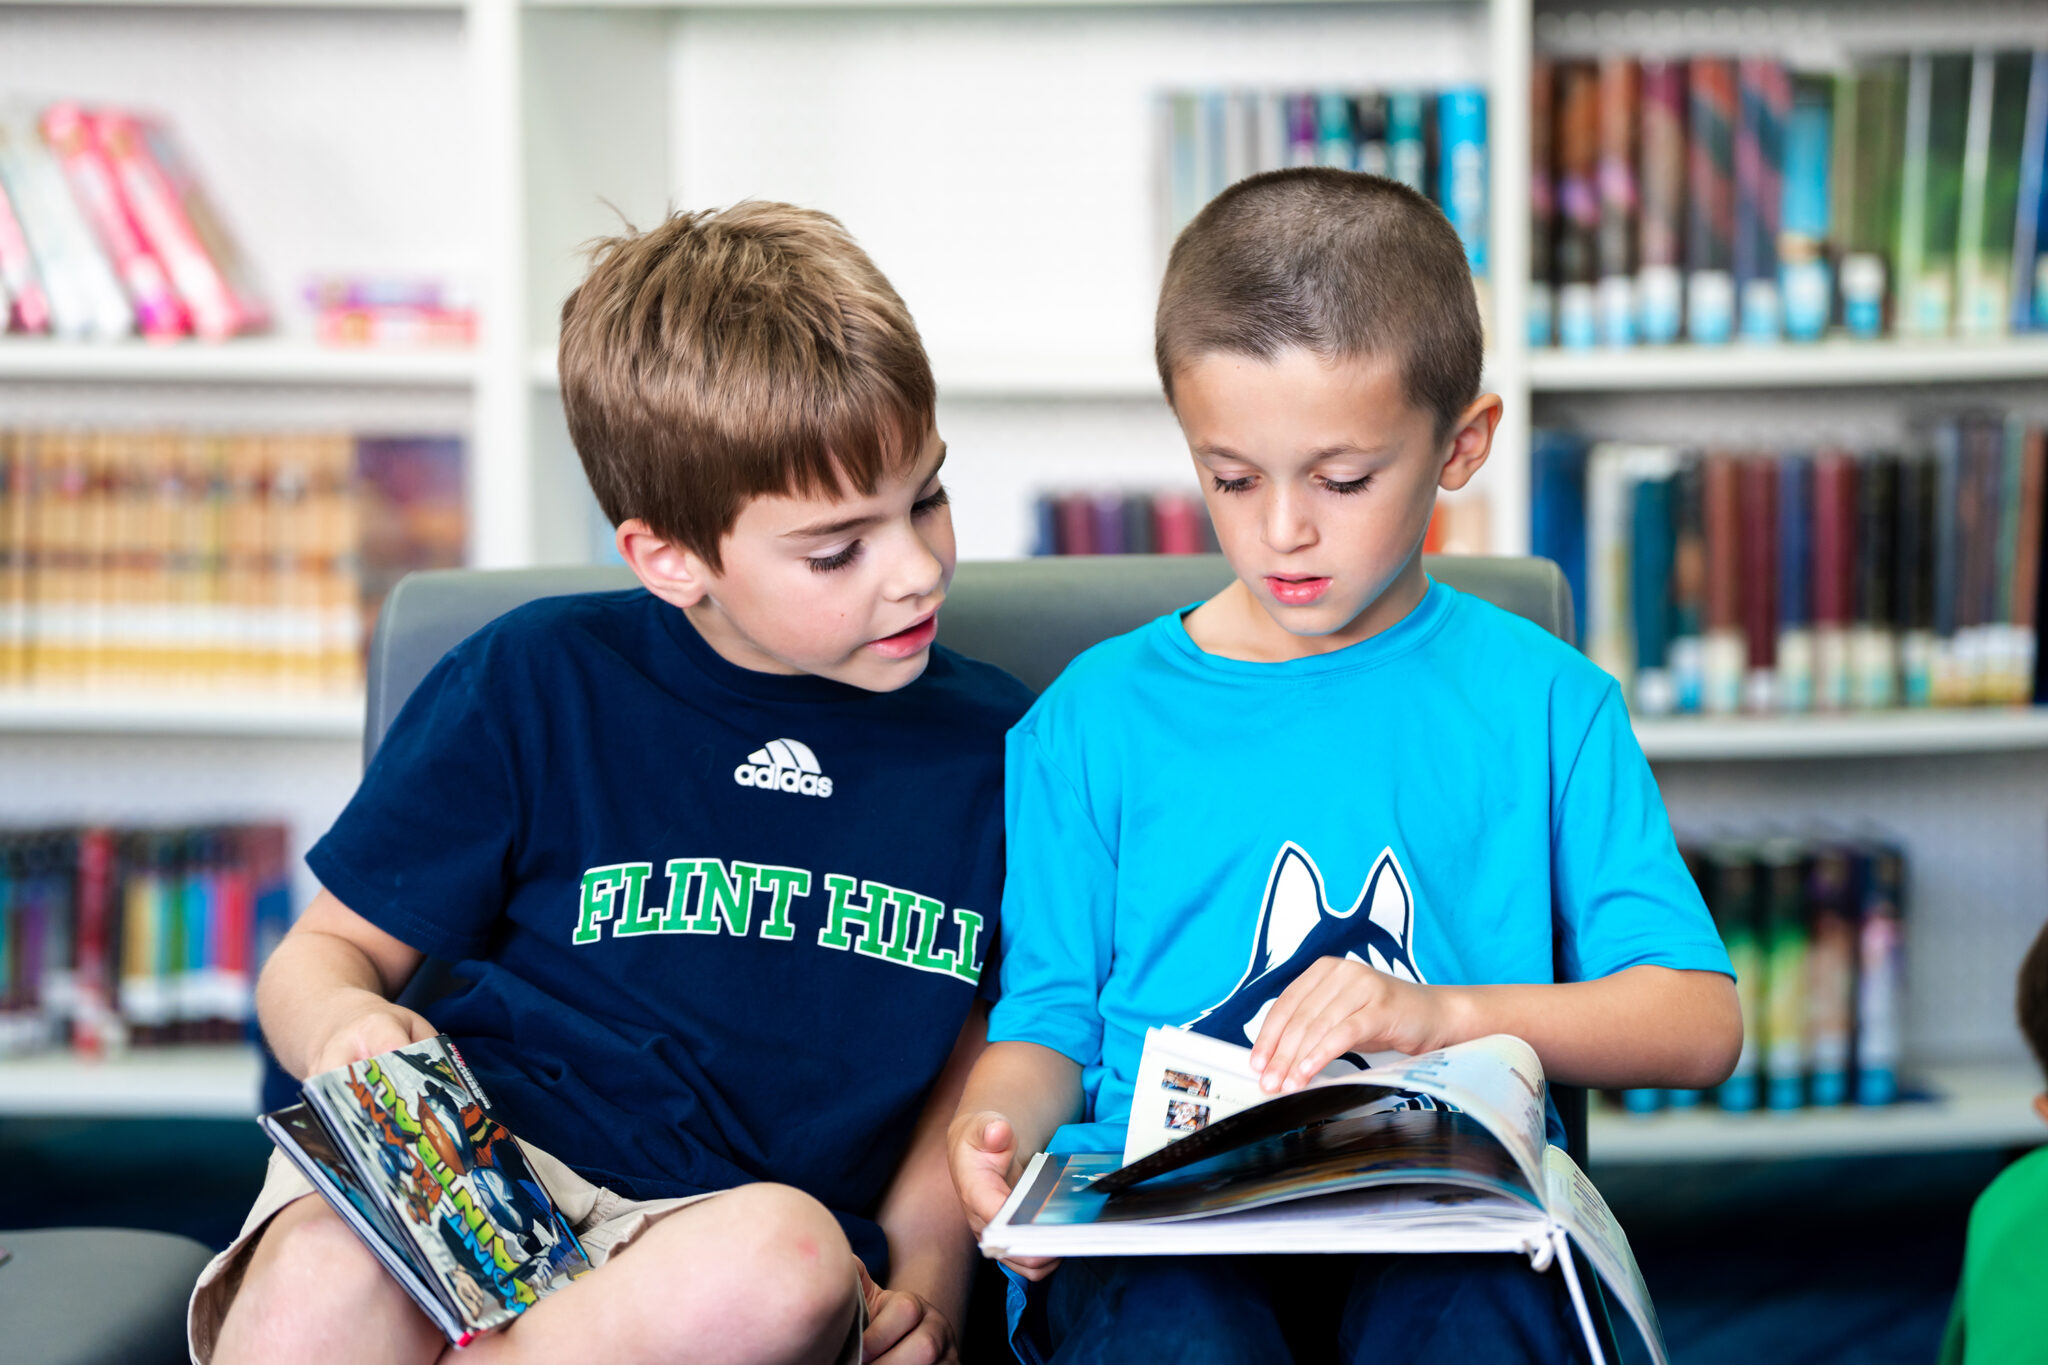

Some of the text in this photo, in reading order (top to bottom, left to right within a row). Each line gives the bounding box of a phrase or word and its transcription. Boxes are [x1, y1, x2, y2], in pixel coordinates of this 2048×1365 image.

[734, 762, 833, 798] adidas
[572, 858, 984, 987] FLINT HILL
[364, 1058, 538, 1307] PAINTBALL
